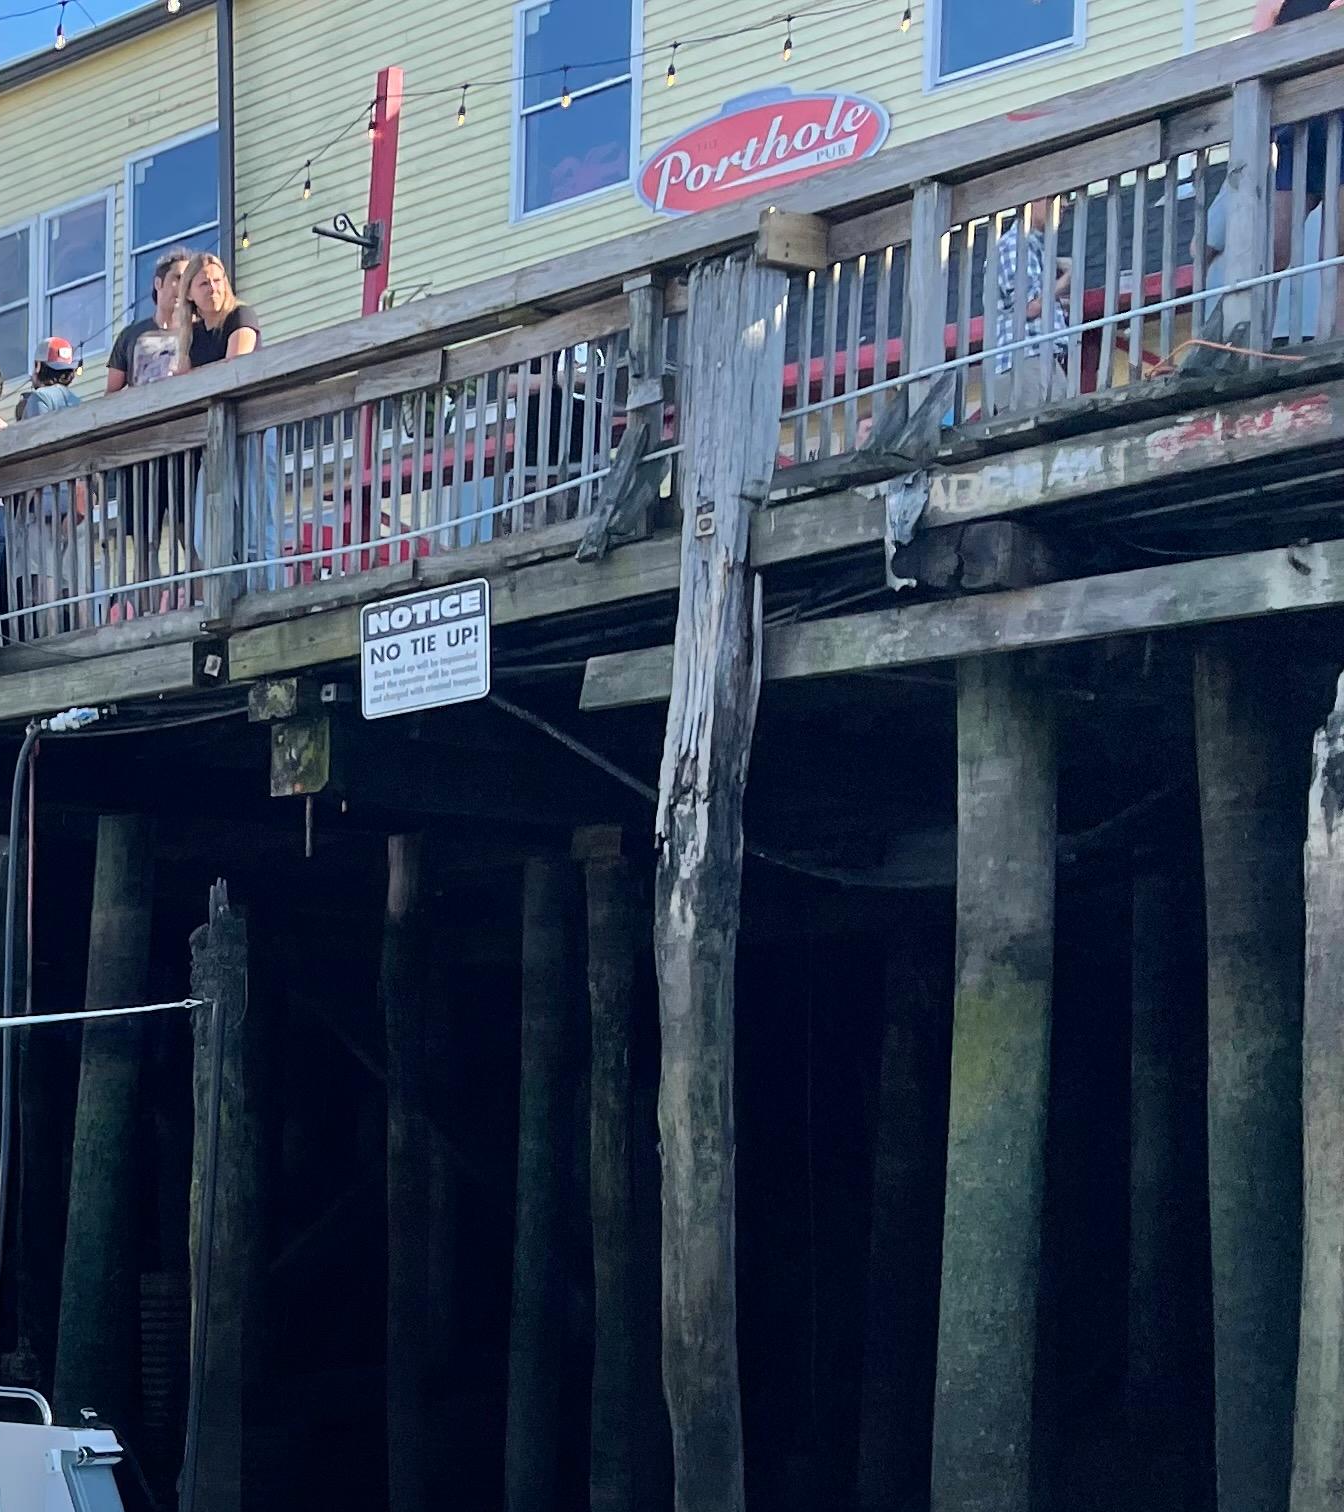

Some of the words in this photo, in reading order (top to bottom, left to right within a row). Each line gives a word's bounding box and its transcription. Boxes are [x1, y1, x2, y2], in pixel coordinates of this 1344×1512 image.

[654, 96, 871, 211] Porthole
[816, 143, 847, 163] PUB
[368, 589, 481, 635] NOTICE
[371, 643, 401, 664] NO
[411, 634, 436, 656] TIE
[447, 625, 479, 647] UP!
